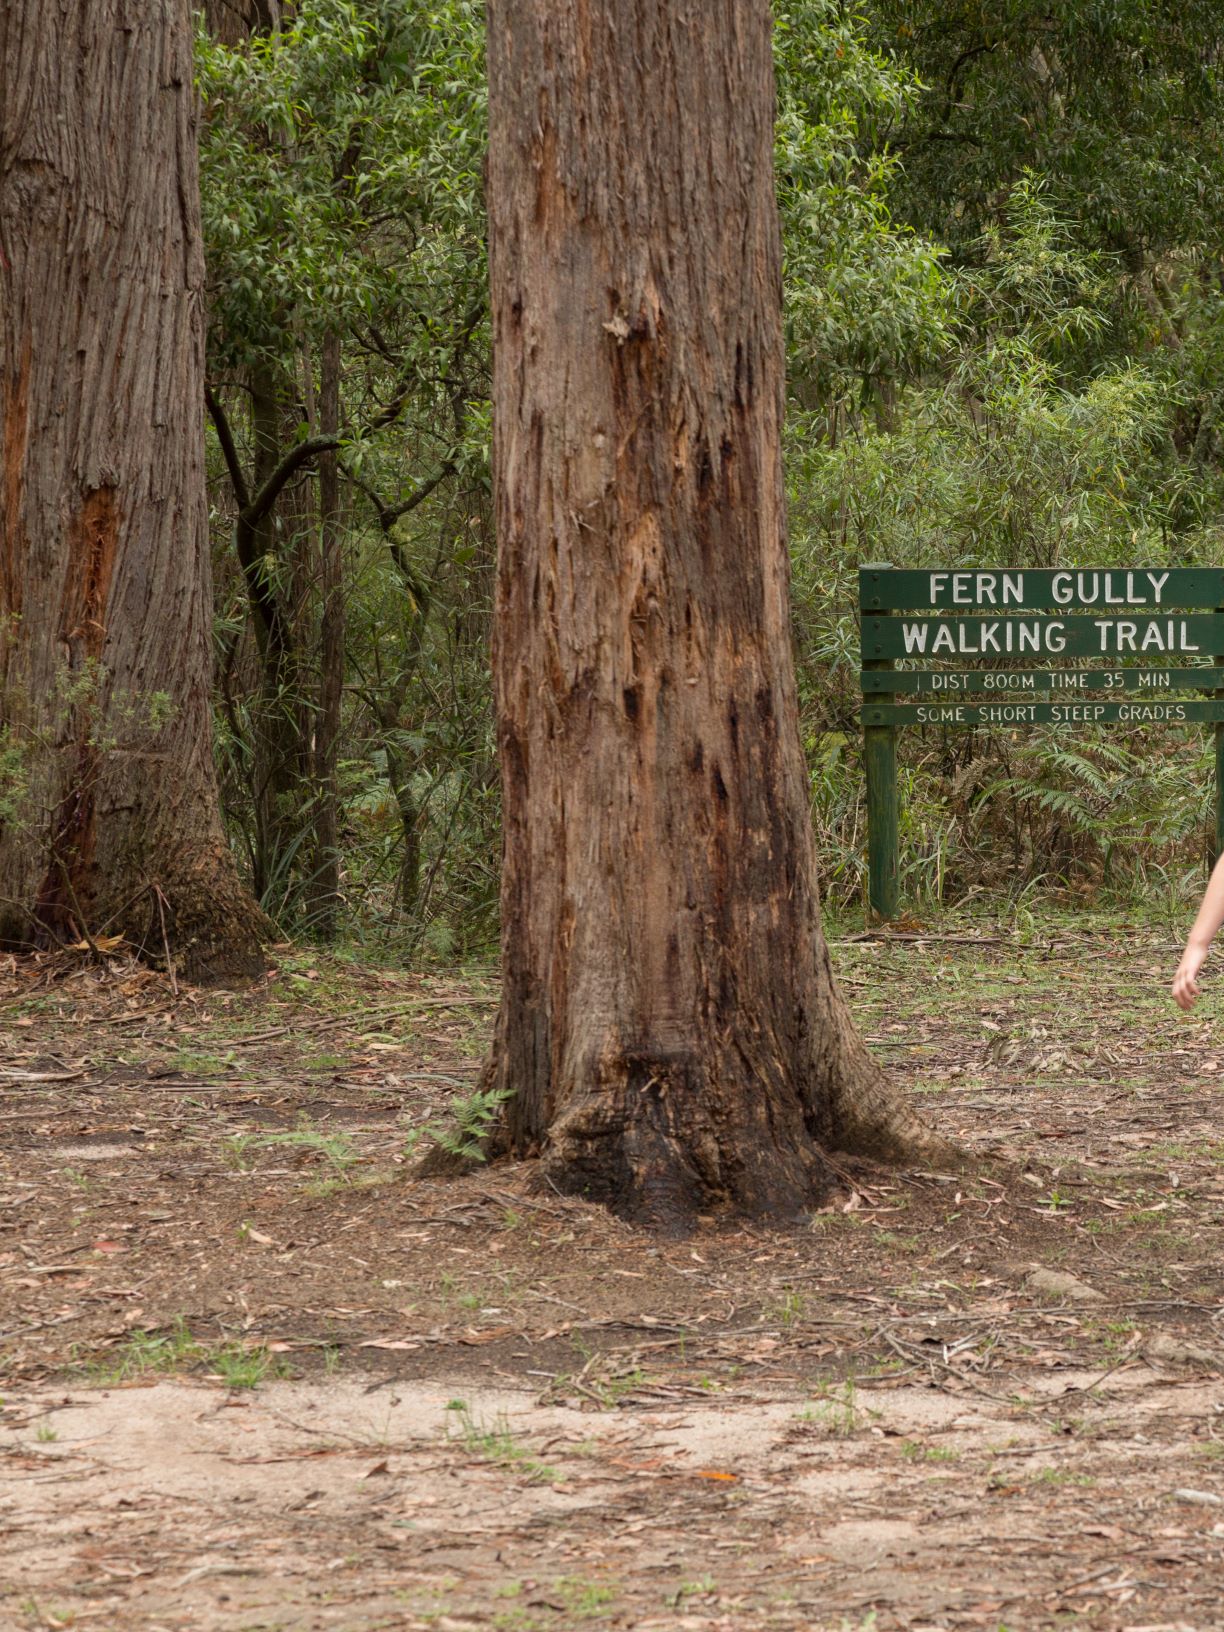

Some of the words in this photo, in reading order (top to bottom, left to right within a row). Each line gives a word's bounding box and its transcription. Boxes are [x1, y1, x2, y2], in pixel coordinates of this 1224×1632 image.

[929, 573, 1024, 604] FERN
[1052, 572, 1170, 604] GULLY
[902, 621, 1067, 653] WALKING
[1094, 620, 1199, 651] TRAIL
[932, 674, 970, 690] DIST
[984, 673, 1035, 689] 800M
[1050, 673, 1088, 689] TIME
[1104, 672, 1125, 688] 35
[1138, 672, 1170, 688] MIN
[916, 706, 965, 723] SOME
[979, 705, 1037, 722] SHORT
[1051, 705, 1105, 721] STEEP
[1119, 704, 1186, 721] GRADES
